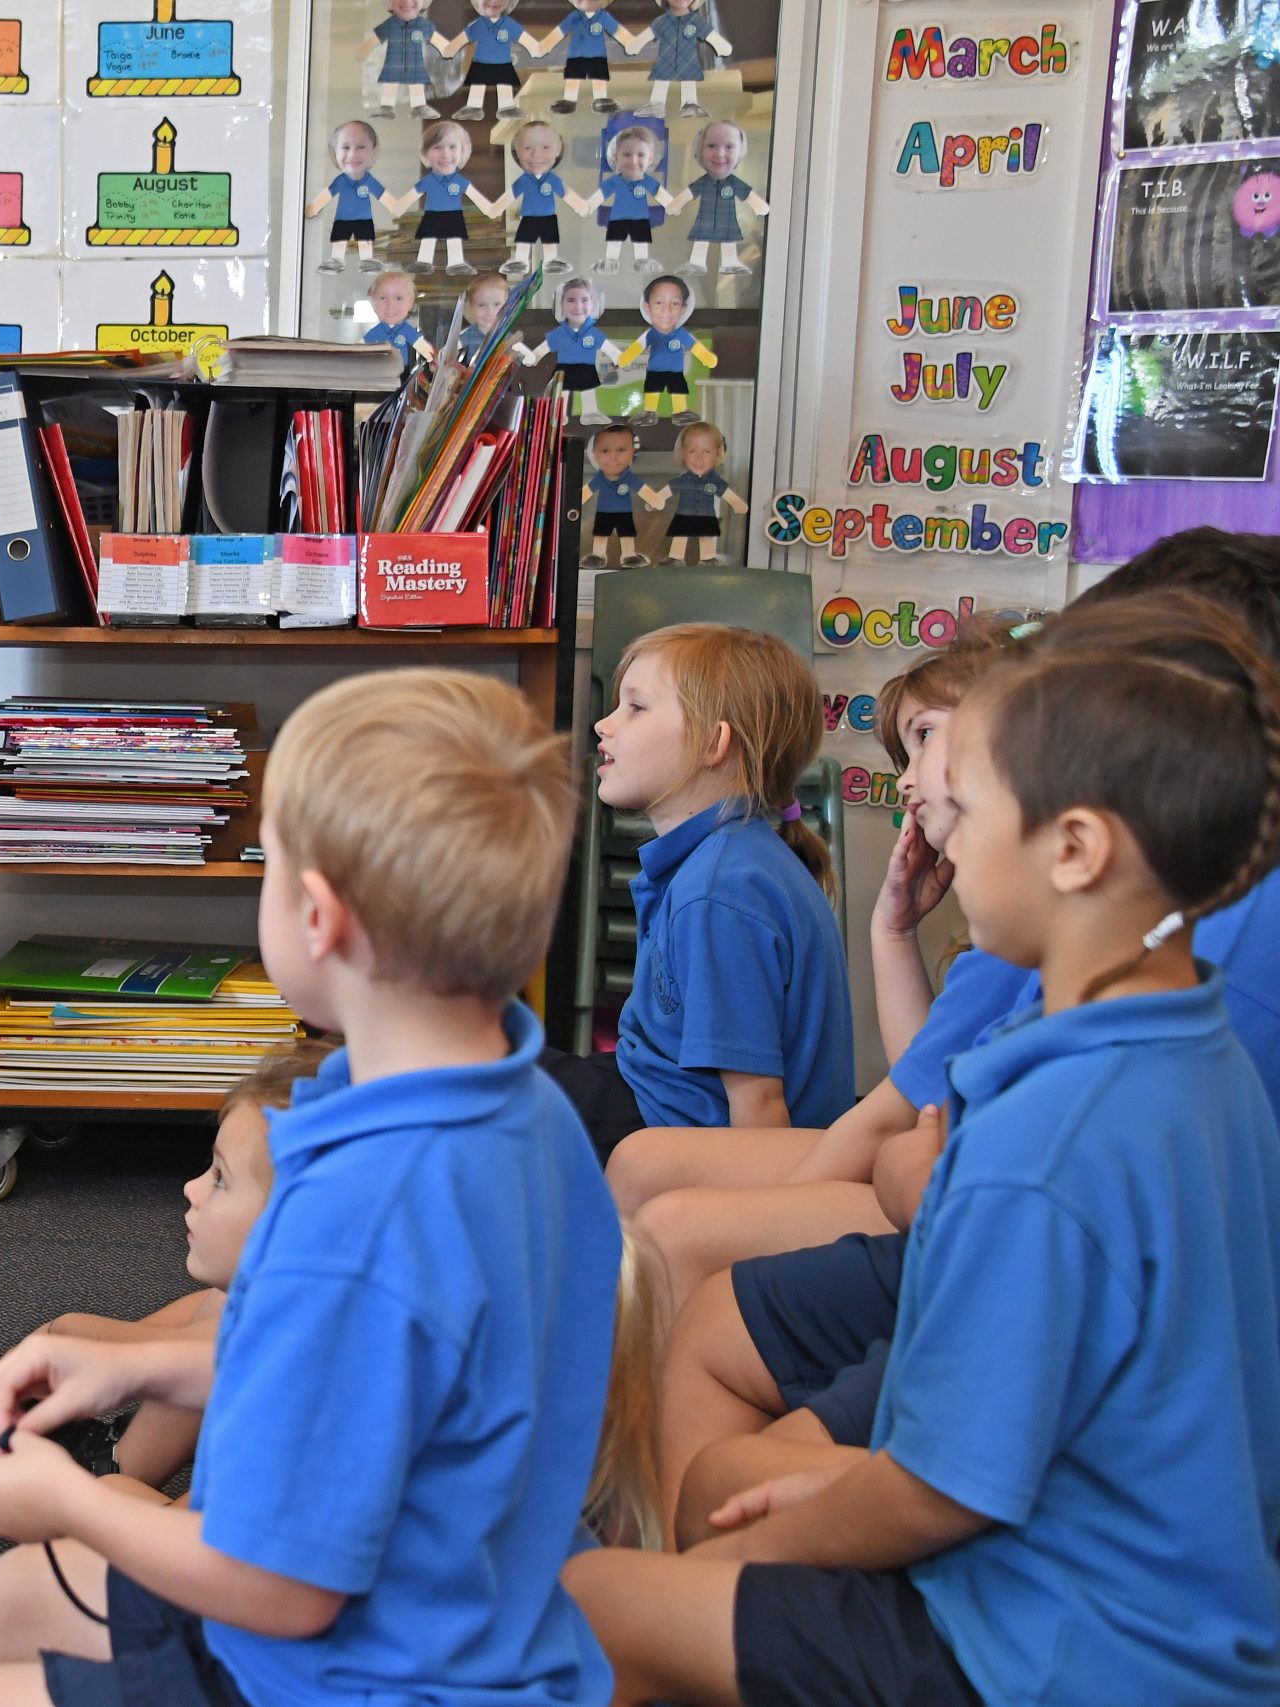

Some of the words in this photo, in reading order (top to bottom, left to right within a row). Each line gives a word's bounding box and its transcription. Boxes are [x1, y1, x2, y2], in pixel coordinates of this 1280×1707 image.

[146, 26, 185, 40] June
[885, 23, 1068, 82] March
[896, 121, 1042, 188] April
[133, 177, 198, 194] August
[1140, 179, 1186, 199] T.I.B.
[105, 198, 135, 212] Bobby
[886, 285, 1017, 336] June
[130, 328, 196, 343] October
[1186, 350, 1254, 370] W.I.L.F.
[889, 352, 1007, 410] July
[847, 433, 1044, 492] August
[767, 493, 1068, 557] September
[377, 558, 462, 578] Reading
[385, 575, 468, 595] Mastery
[820, 596, 976, 648] Octo
